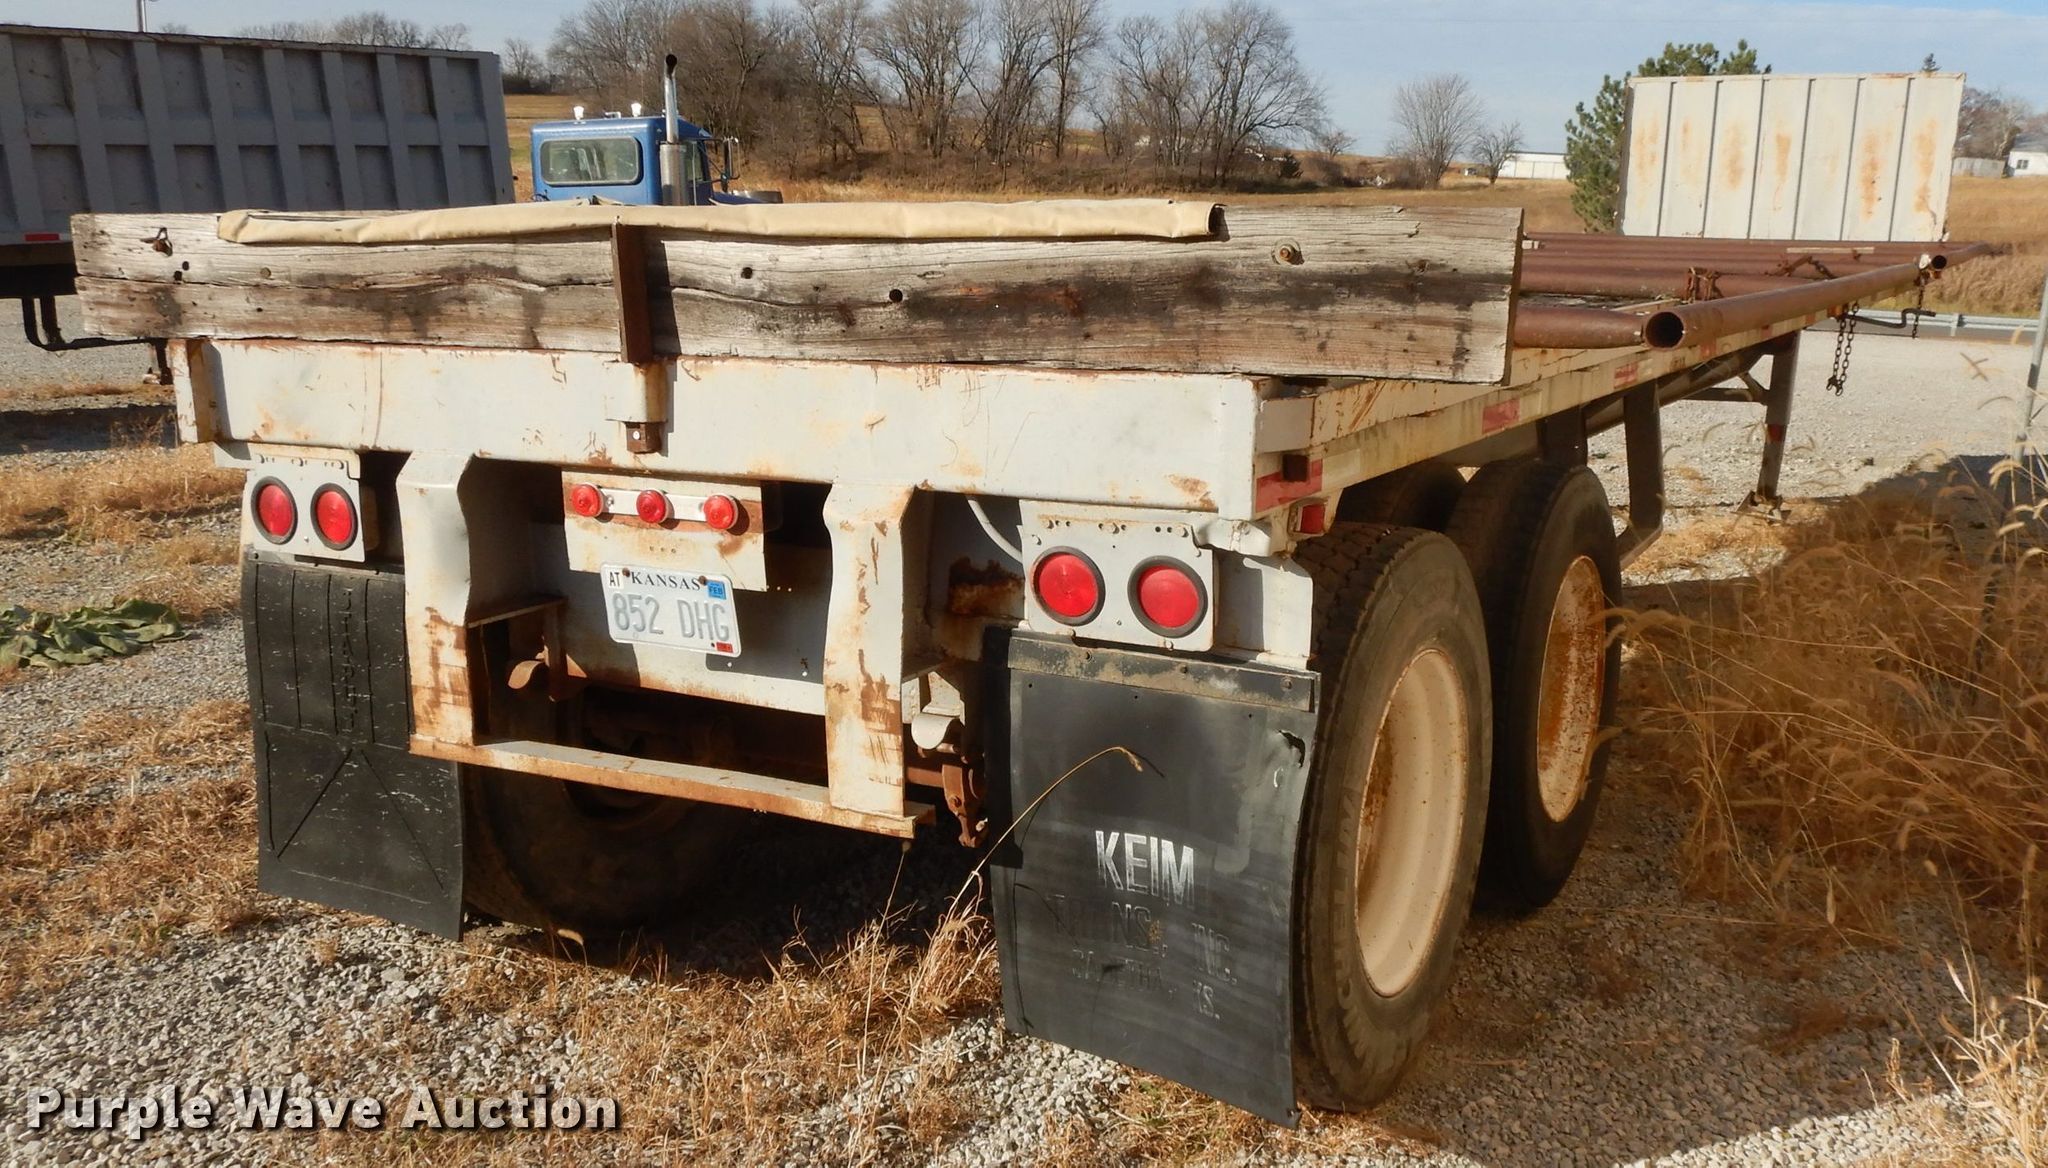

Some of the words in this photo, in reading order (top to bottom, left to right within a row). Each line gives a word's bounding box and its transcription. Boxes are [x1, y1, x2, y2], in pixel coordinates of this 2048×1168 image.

[609, 571, 620, 587] AT
[631, 571, 700, 591] KANSAS
[612, 593, 664, 634] 852
[677, 600, 729, 641] DHG
[1095, 830, 1195, 908] KEIM
